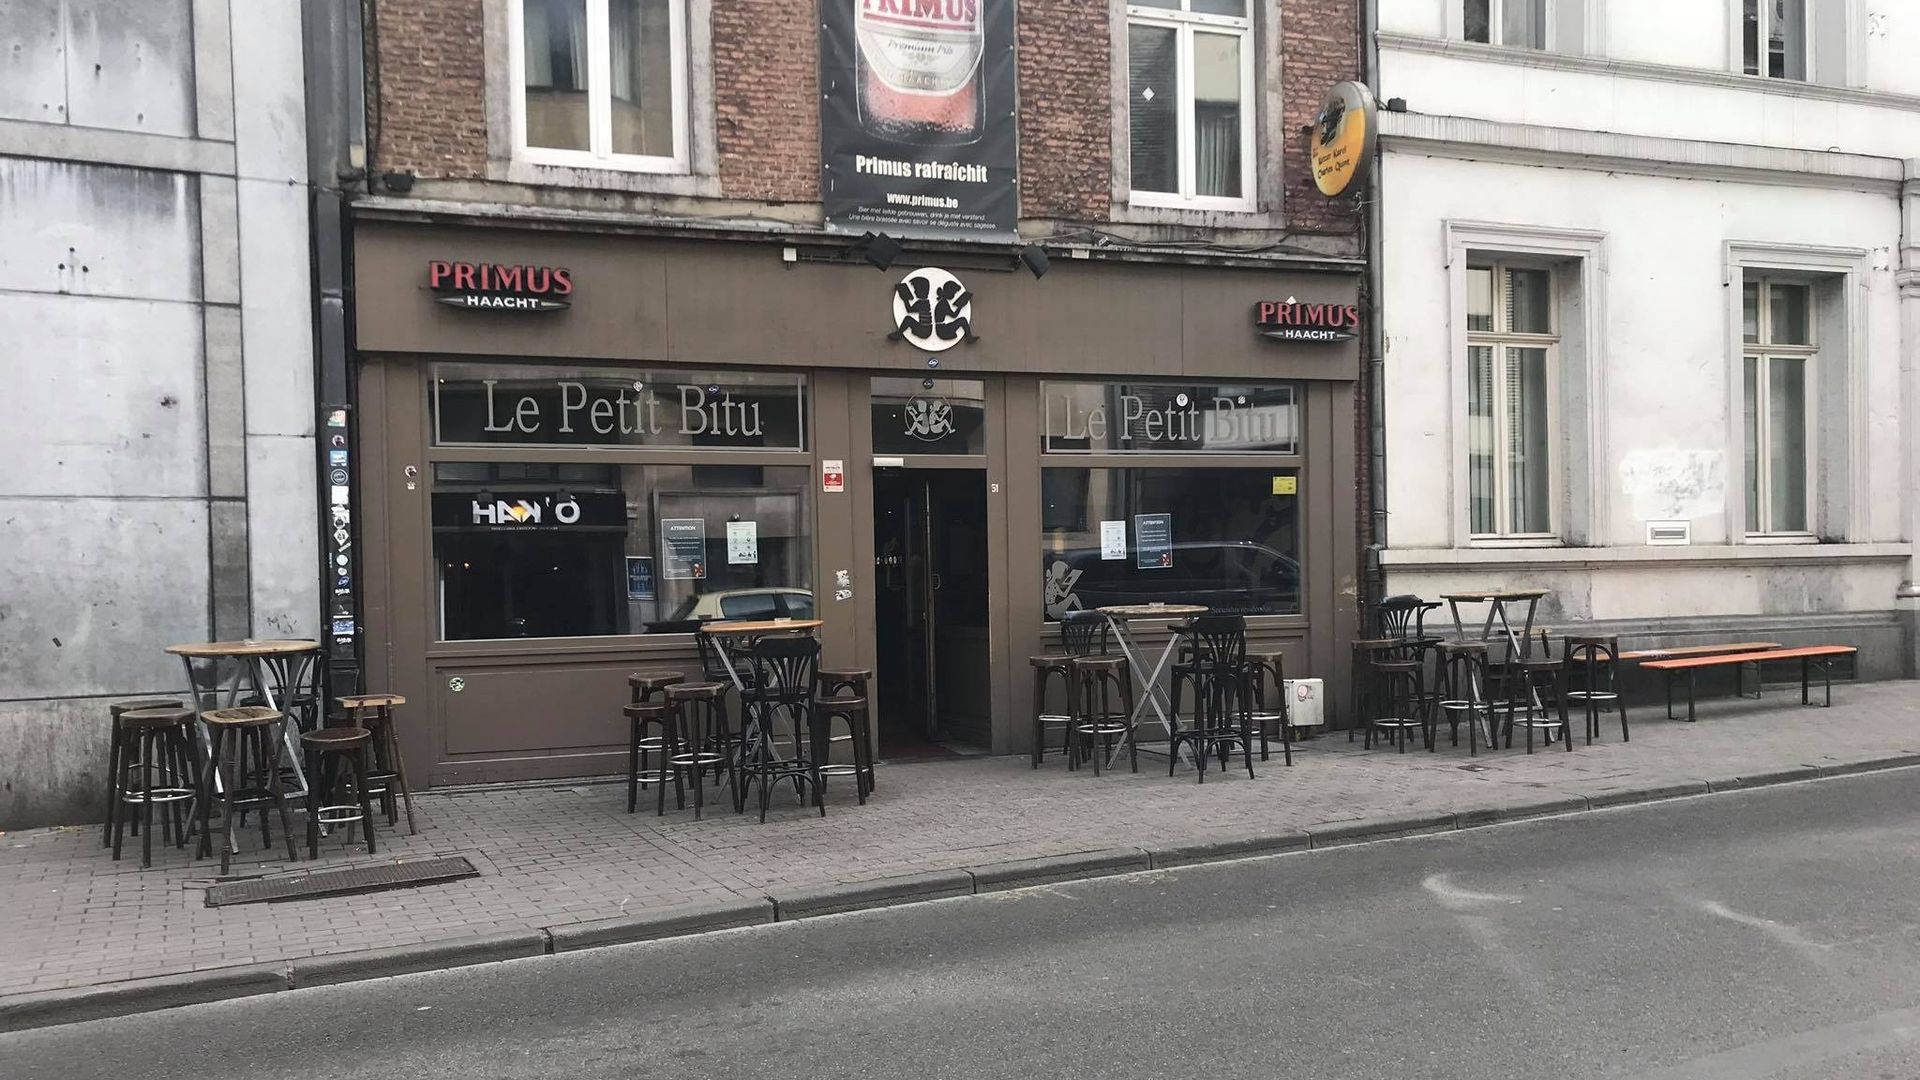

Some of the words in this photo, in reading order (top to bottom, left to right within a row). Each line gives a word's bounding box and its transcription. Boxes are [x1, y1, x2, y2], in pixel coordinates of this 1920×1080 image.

[855, 154, 912, 178] Primus
[914, 161, 988, 183] rafraîchit
[886, 193, 959, 209] www.primus.be
[429, 261, 573, 295] PRIMUS
[466, 295, 539, 309] HAACHT
[1258, 302, 1360, 328] PRIMUS
[1285, 330, 1336, 340] HAACHT
[482, 380, 541, 434] Le
[557, 381, 663, 435] Petit
[676, 384, 764, 437] Bitu
[1063, 395, 1107, 441] Le
[1120, 395, 1201, 442] Petit
[1210, 397, 1278, 443] Bitu
